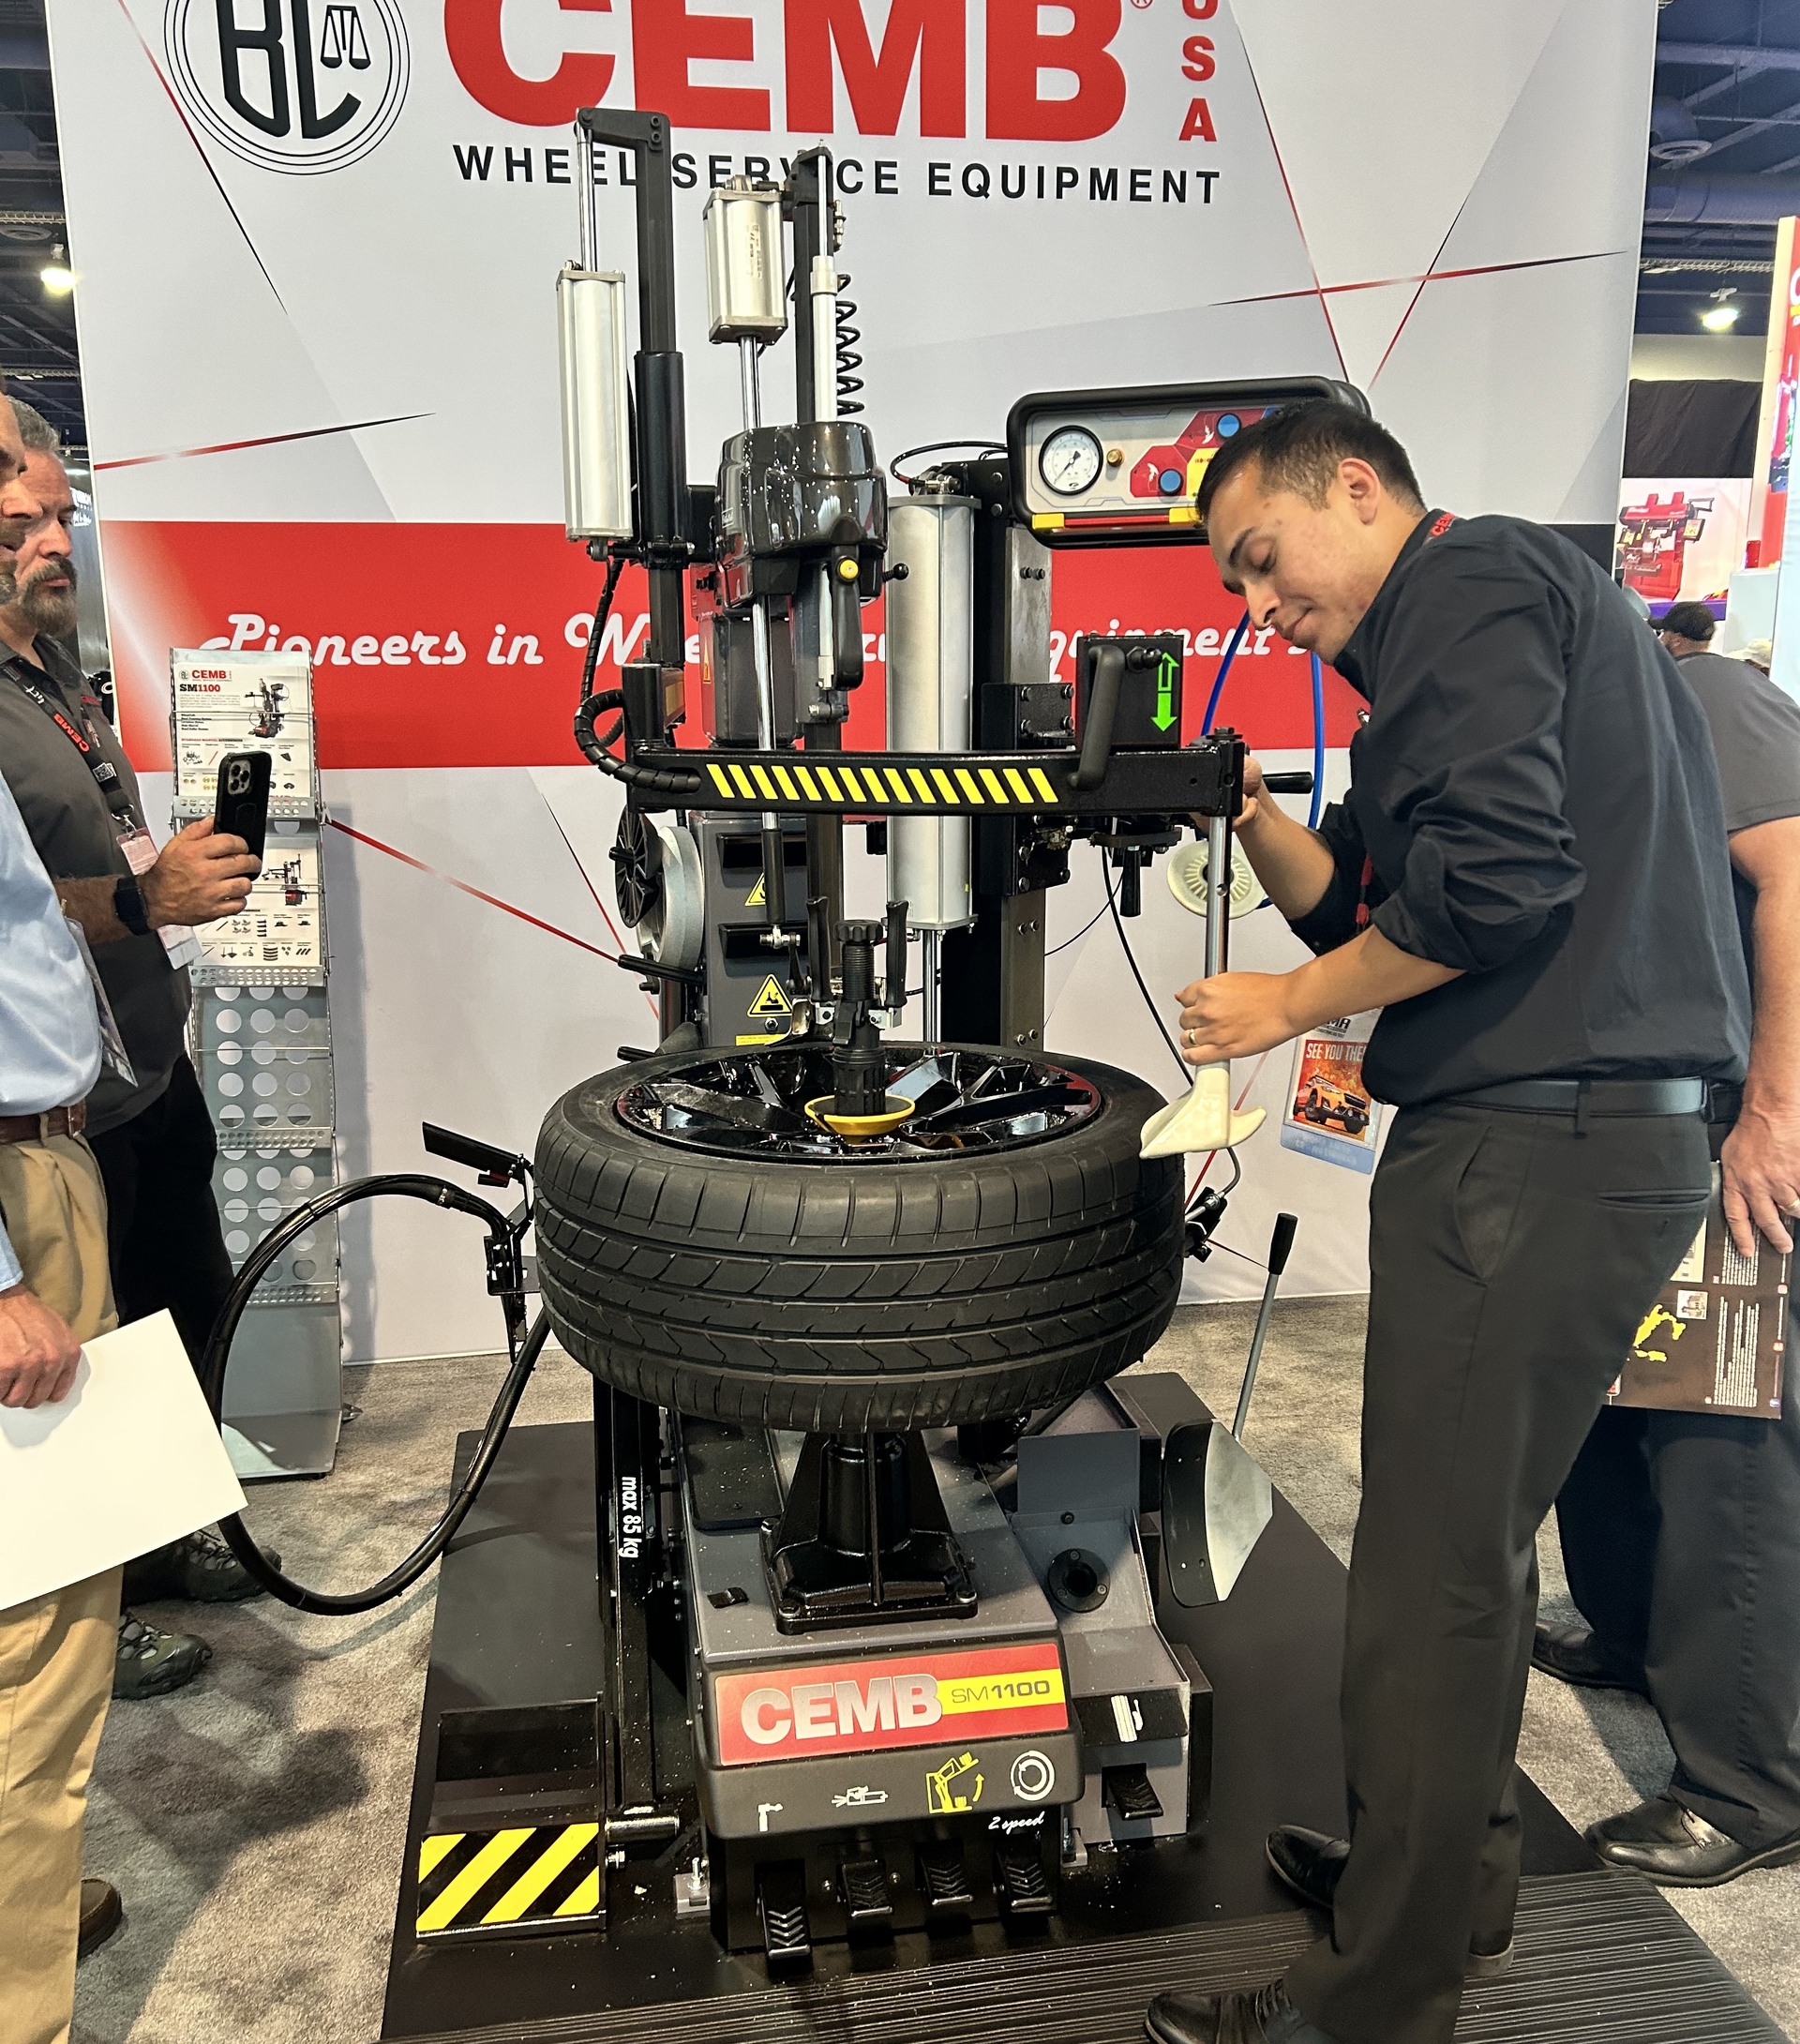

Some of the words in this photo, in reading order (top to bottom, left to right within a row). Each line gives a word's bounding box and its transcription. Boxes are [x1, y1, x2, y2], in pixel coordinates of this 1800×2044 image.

[443, 0, 1126, 142] CEMB
[453, 144, 636, 185] WHEEL
[671, 153, 899, 195] SERCE
[928, 161, 1220, 203] EQUIPMENT
[487, 624, 544, 666] in
[179, 684, 221, 693] SM1100
[191, 669, 227, 679] CEMB
[53, 713, 90, 752] CEMB
[1305, 1042, 1324, 1060] SEE
[1325, 1044, 1344, 1061] YOU
[1345, 1045, 1367, 1062] THE
[622, 1476, 638, 1511] max
[622, 1514, 642, 1534] 85
[618, 1537, 642, 1558] kg
[741, 1673, 943, 1745] CEMB
[951, 1679, 1051, 1705] SM1100
[987, 1815, 1001, 1830] 2
[1001, 1811, 1045, 1835] speed
